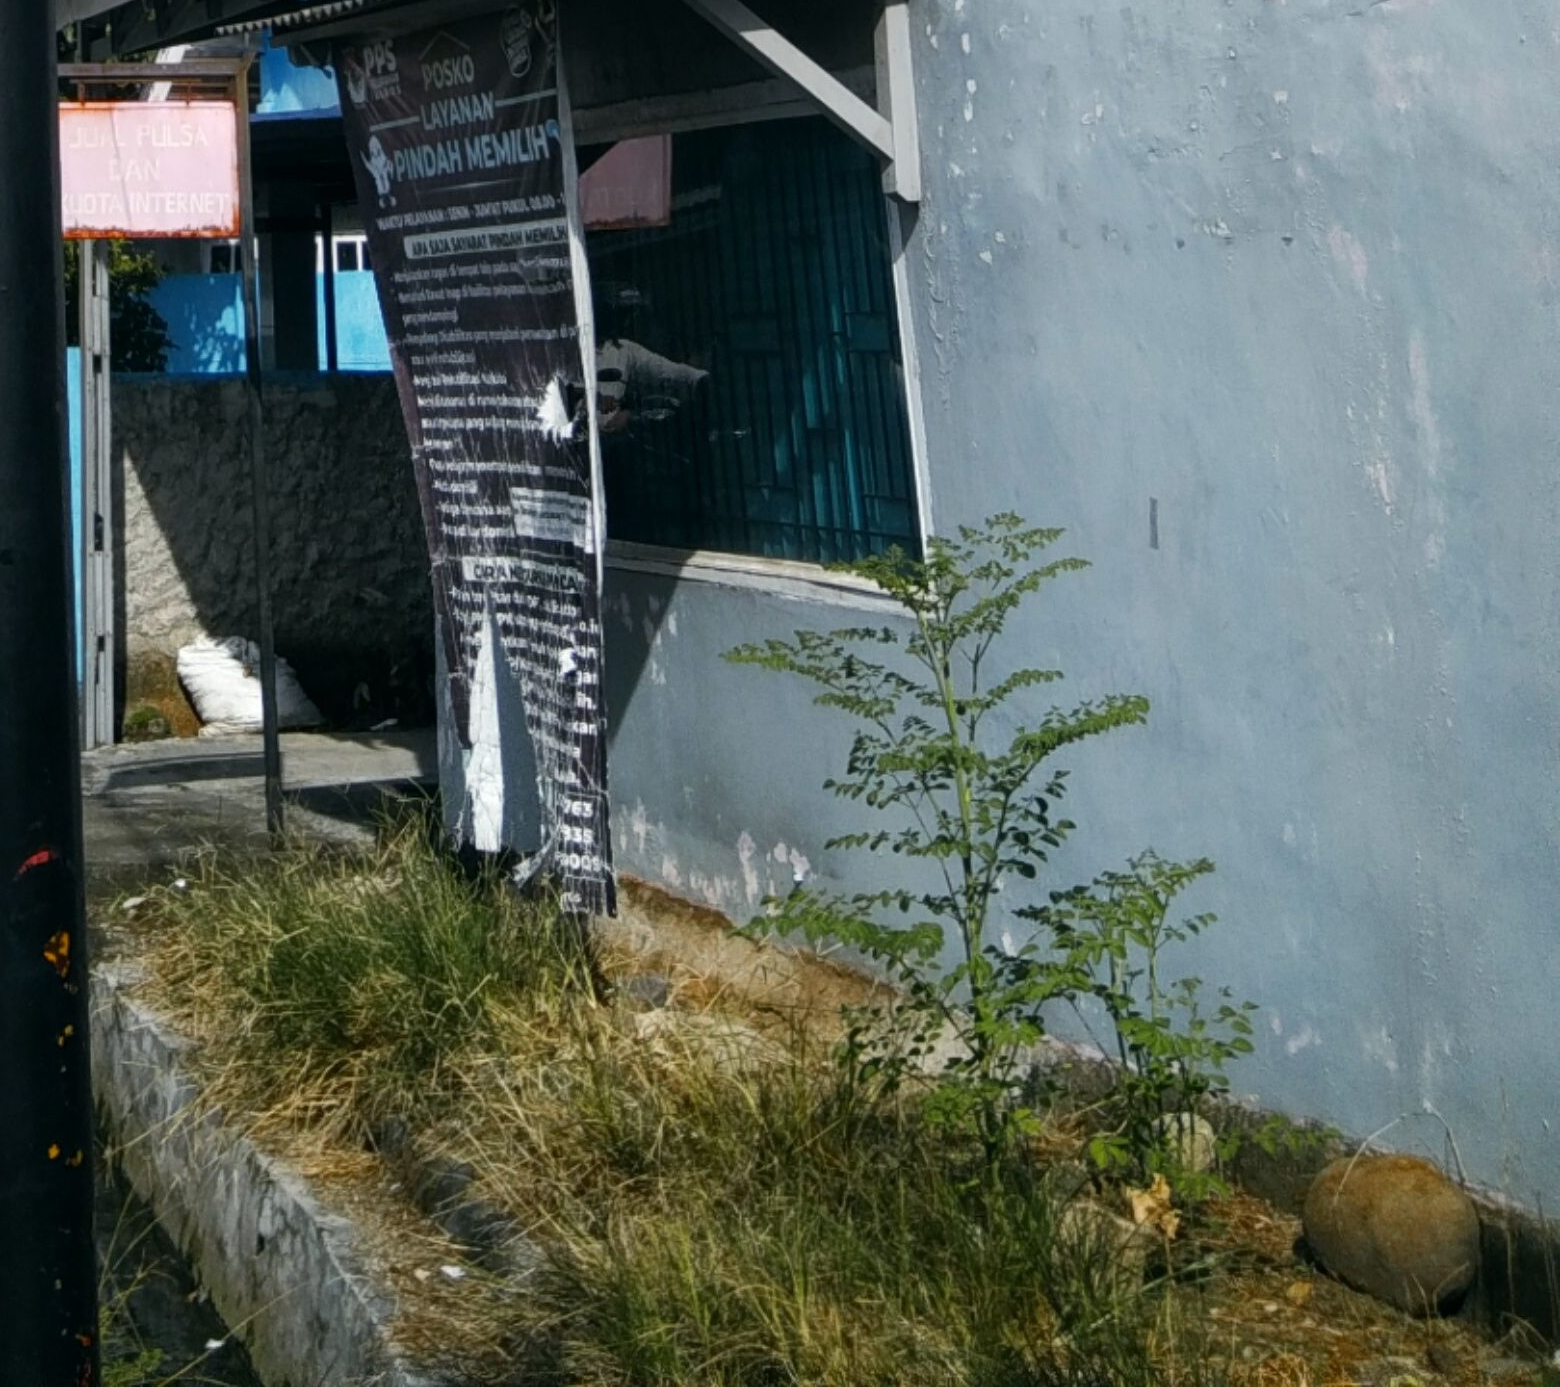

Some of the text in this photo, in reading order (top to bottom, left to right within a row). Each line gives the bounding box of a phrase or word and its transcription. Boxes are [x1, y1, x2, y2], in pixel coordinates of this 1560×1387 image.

[363, 39, 399, 75] PPS
[420, 54, 475, 92] POSKO
[420, 91, 495, 131] LAYANAN
[69, 123, 209, 148] JUAL PULSA
[393, 123, 550, 182] PINDAH MEMILIH
[129, 191, 231, 214] INTERNET
